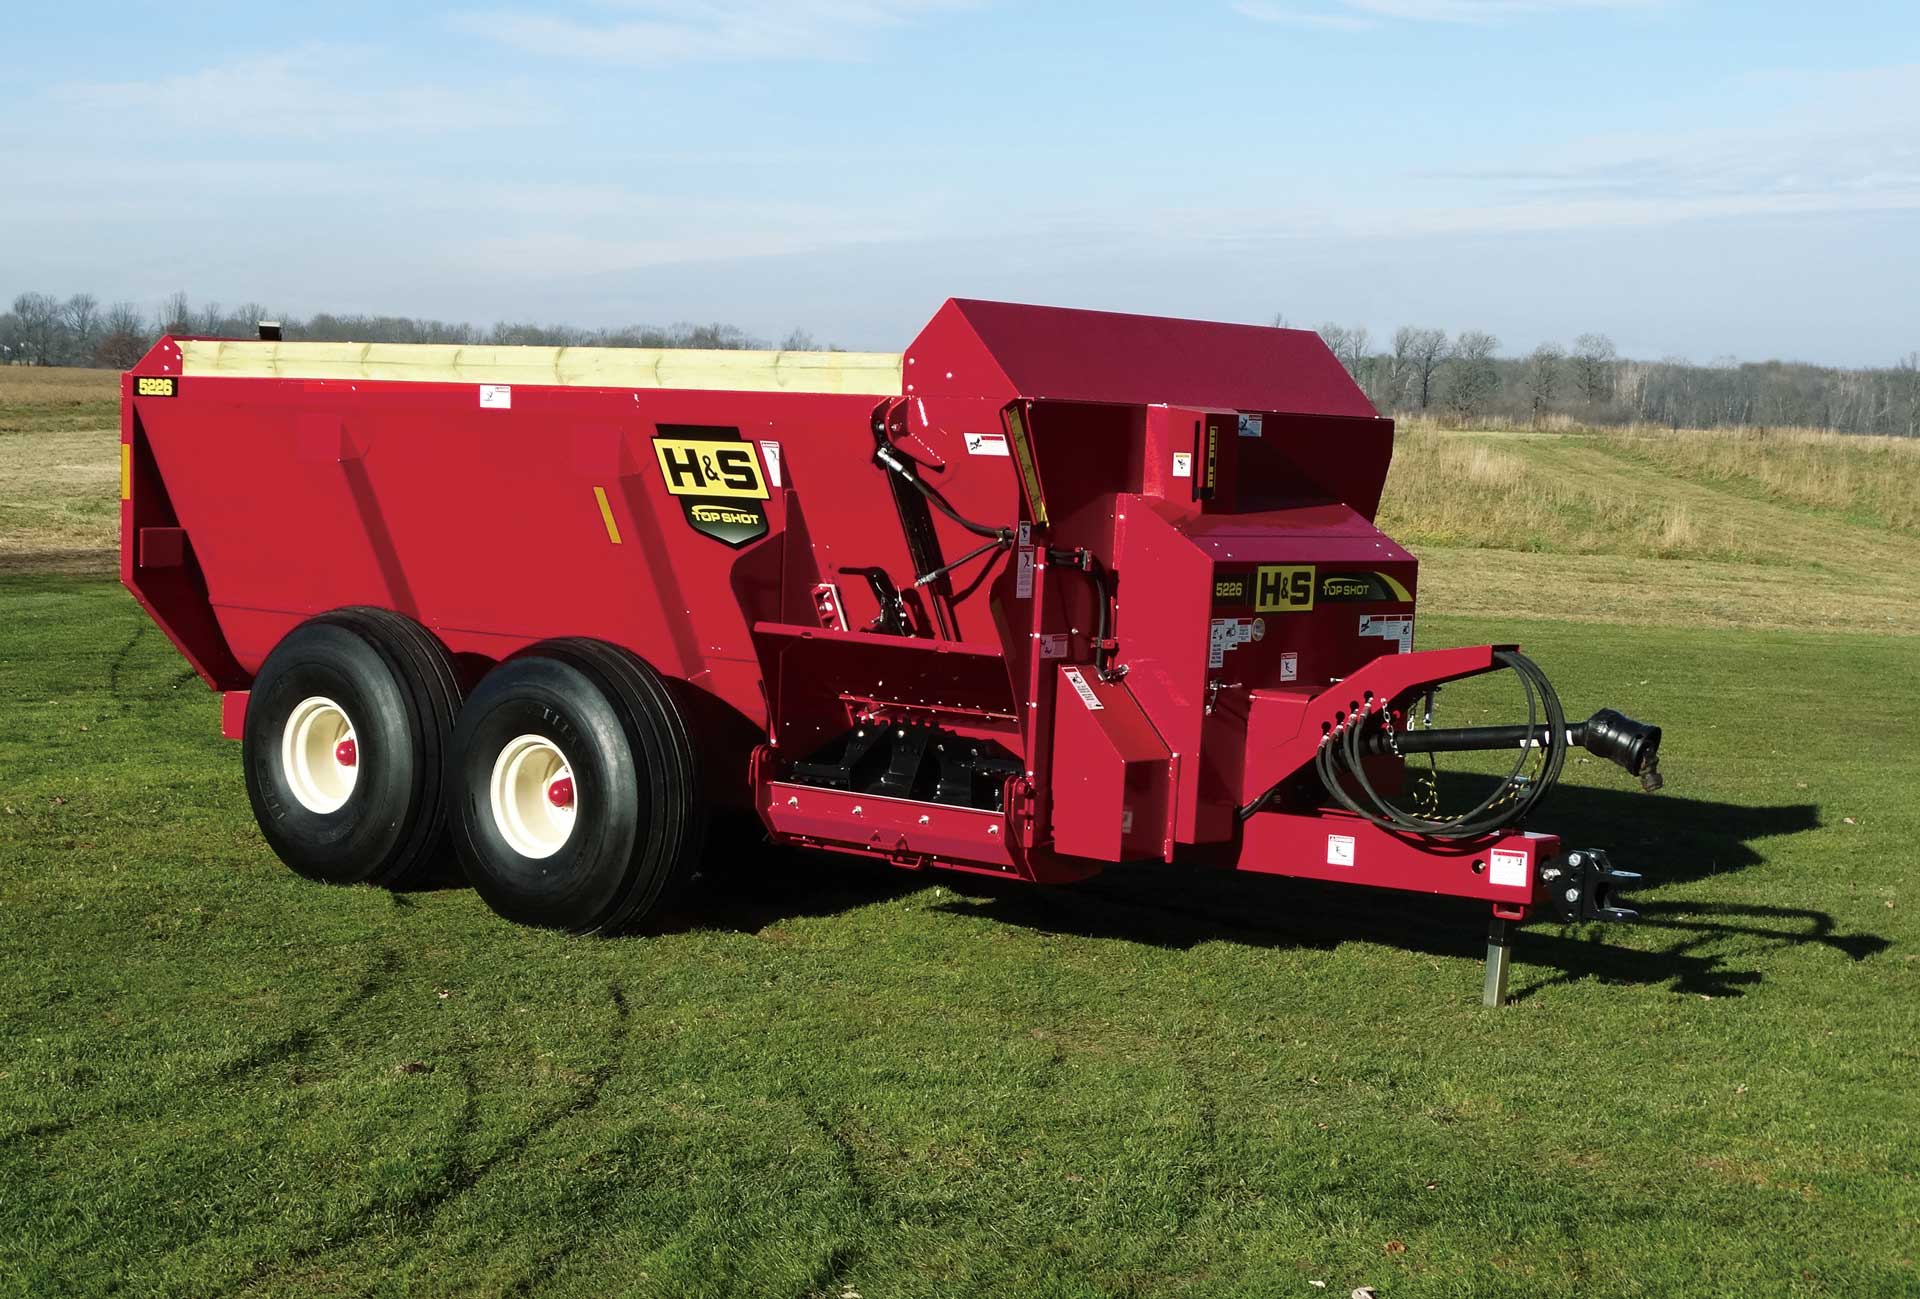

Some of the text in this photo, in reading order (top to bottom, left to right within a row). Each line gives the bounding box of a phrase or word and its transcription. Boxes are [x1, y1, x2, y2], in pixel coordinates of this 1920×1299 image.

[139, 378, 172, 396] 5226
[662, 447, 758, 490] H&S
[691, 509, 759, 525] TOP SHOT
[1215, 582, 1242, 597] 5226
[1260, 571, 1311, 606] H&S
[1322, 583, 1369, 596] TOP SHOT
